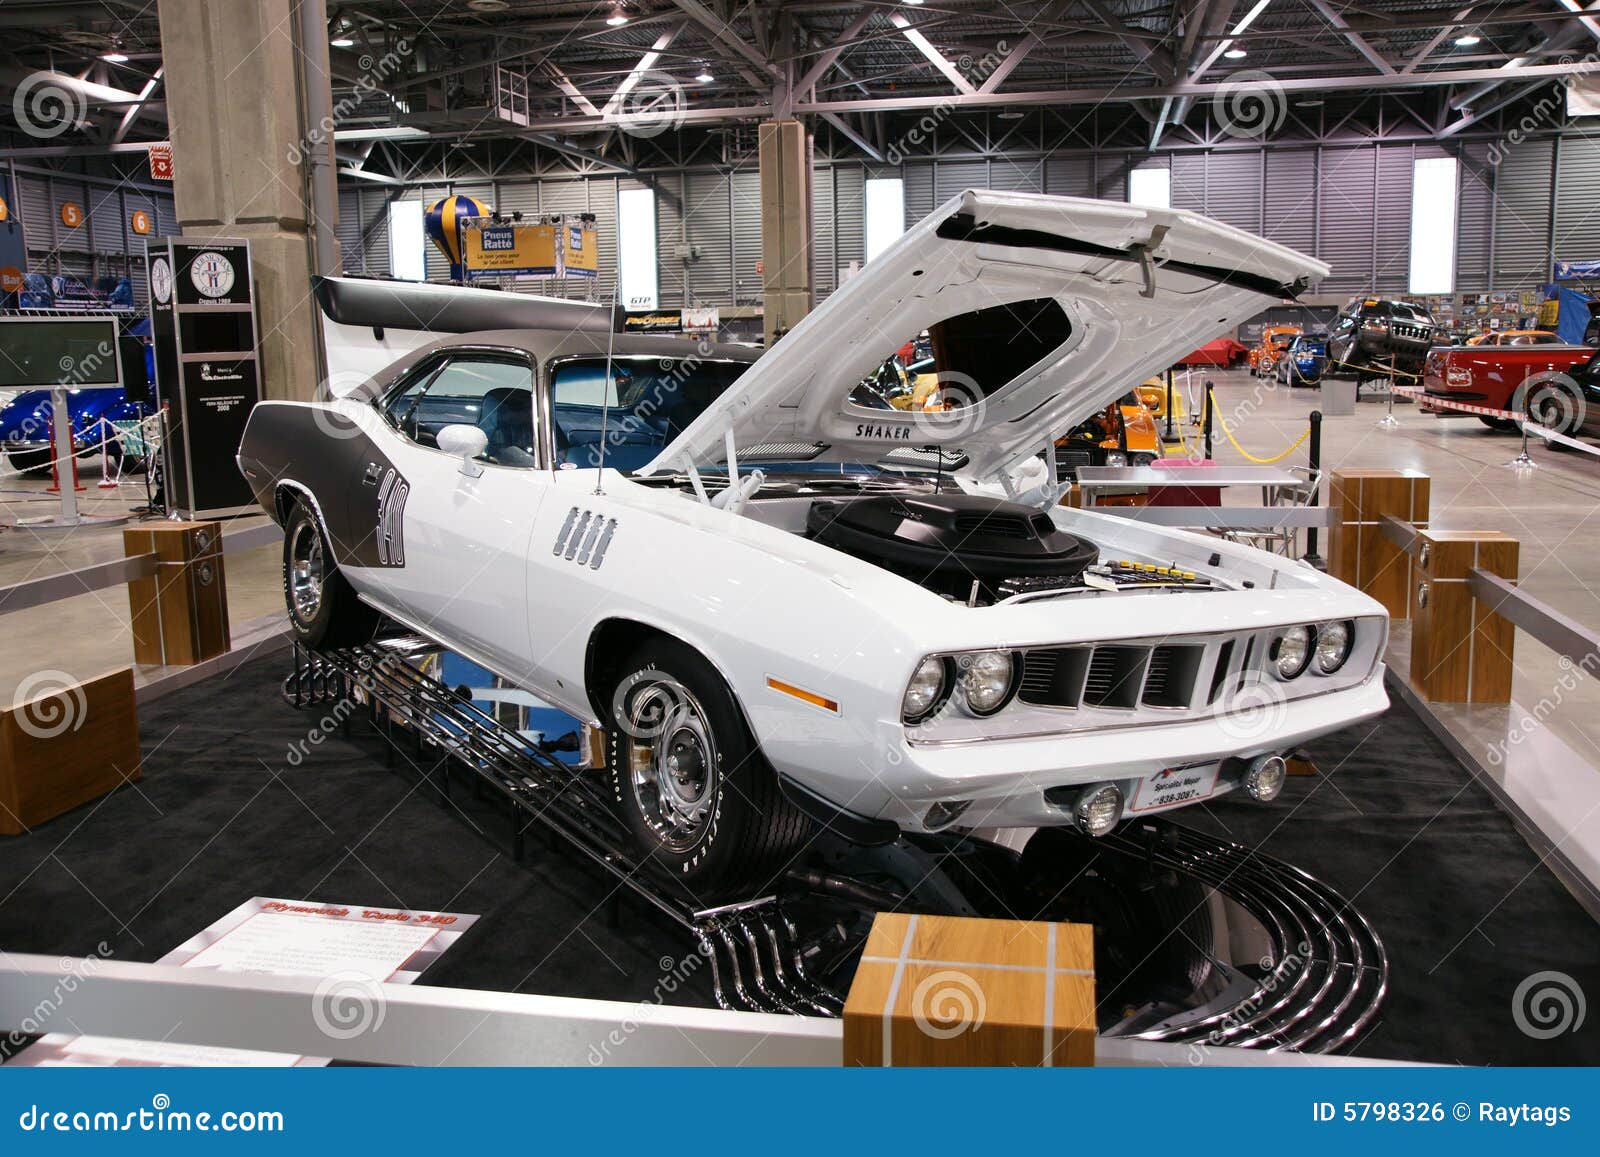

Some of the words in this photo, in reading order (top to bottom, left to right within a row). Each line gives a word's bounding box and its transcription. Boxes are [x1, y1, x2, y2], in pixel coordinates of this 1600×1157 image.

[67, 207, 77, 223] 5
[137, 215, 145, 230] 6
[483, 231, 513, 239] Pneus
[483, 238, 513, 249] Ratté
[2, 275, 20, 285] Bar
[855, 424, 910, 440] SHAKER
[260, 901, 350, 917] Plymouth
[413, 914, 458, 925] 340
